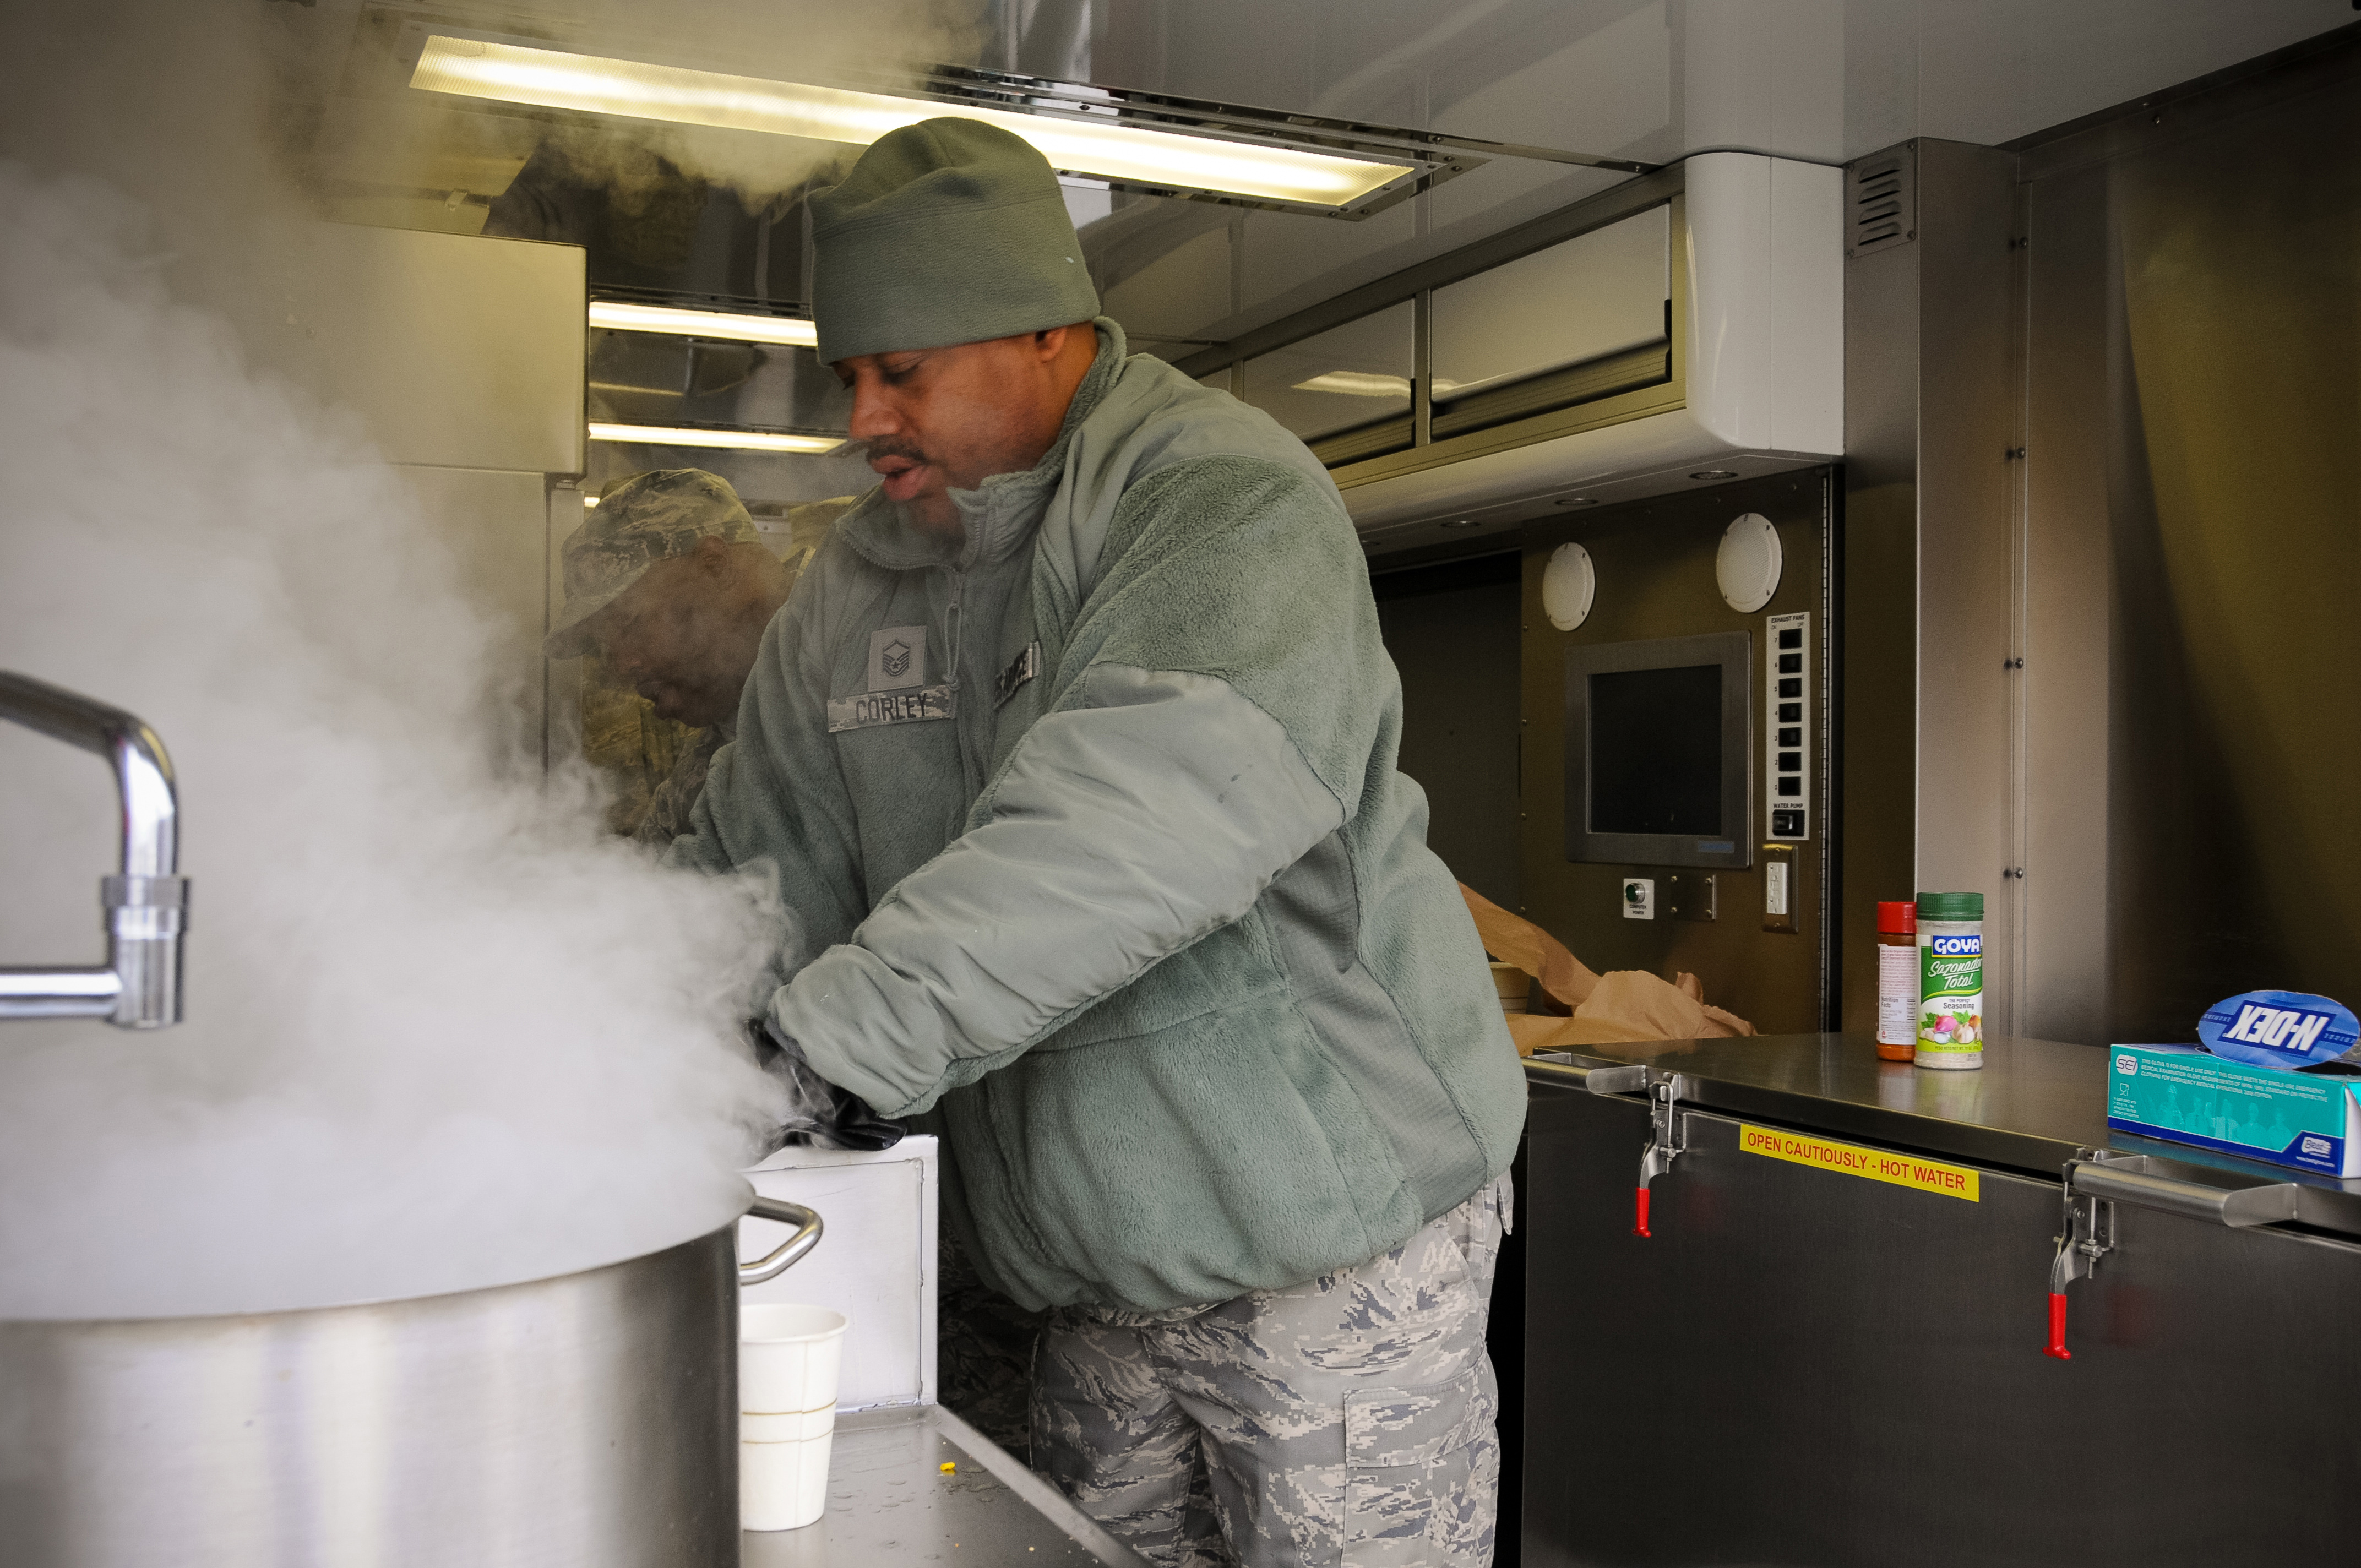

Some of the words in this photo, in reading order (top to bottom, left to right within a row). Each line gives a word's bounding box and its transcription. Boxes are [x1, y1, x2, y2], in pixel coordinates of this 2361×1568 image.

[856, 692, 928, 725] CORLEY
[1934, 938, 1979, 954] GOYA
[1943, 973, 1973, 990] Total
[2226, 1005, 2330, 1051] N-DEX
[2116, 1058, 2137, 1071] SEI
[1747, 1132, 1781, 1152] OPEN
[1785, 1140, 1868, 1170] CAUTIOUSLY
[1880, 1159, 1910, 1178] HOT
[1913, 1165, 1966, 1191] WATER
